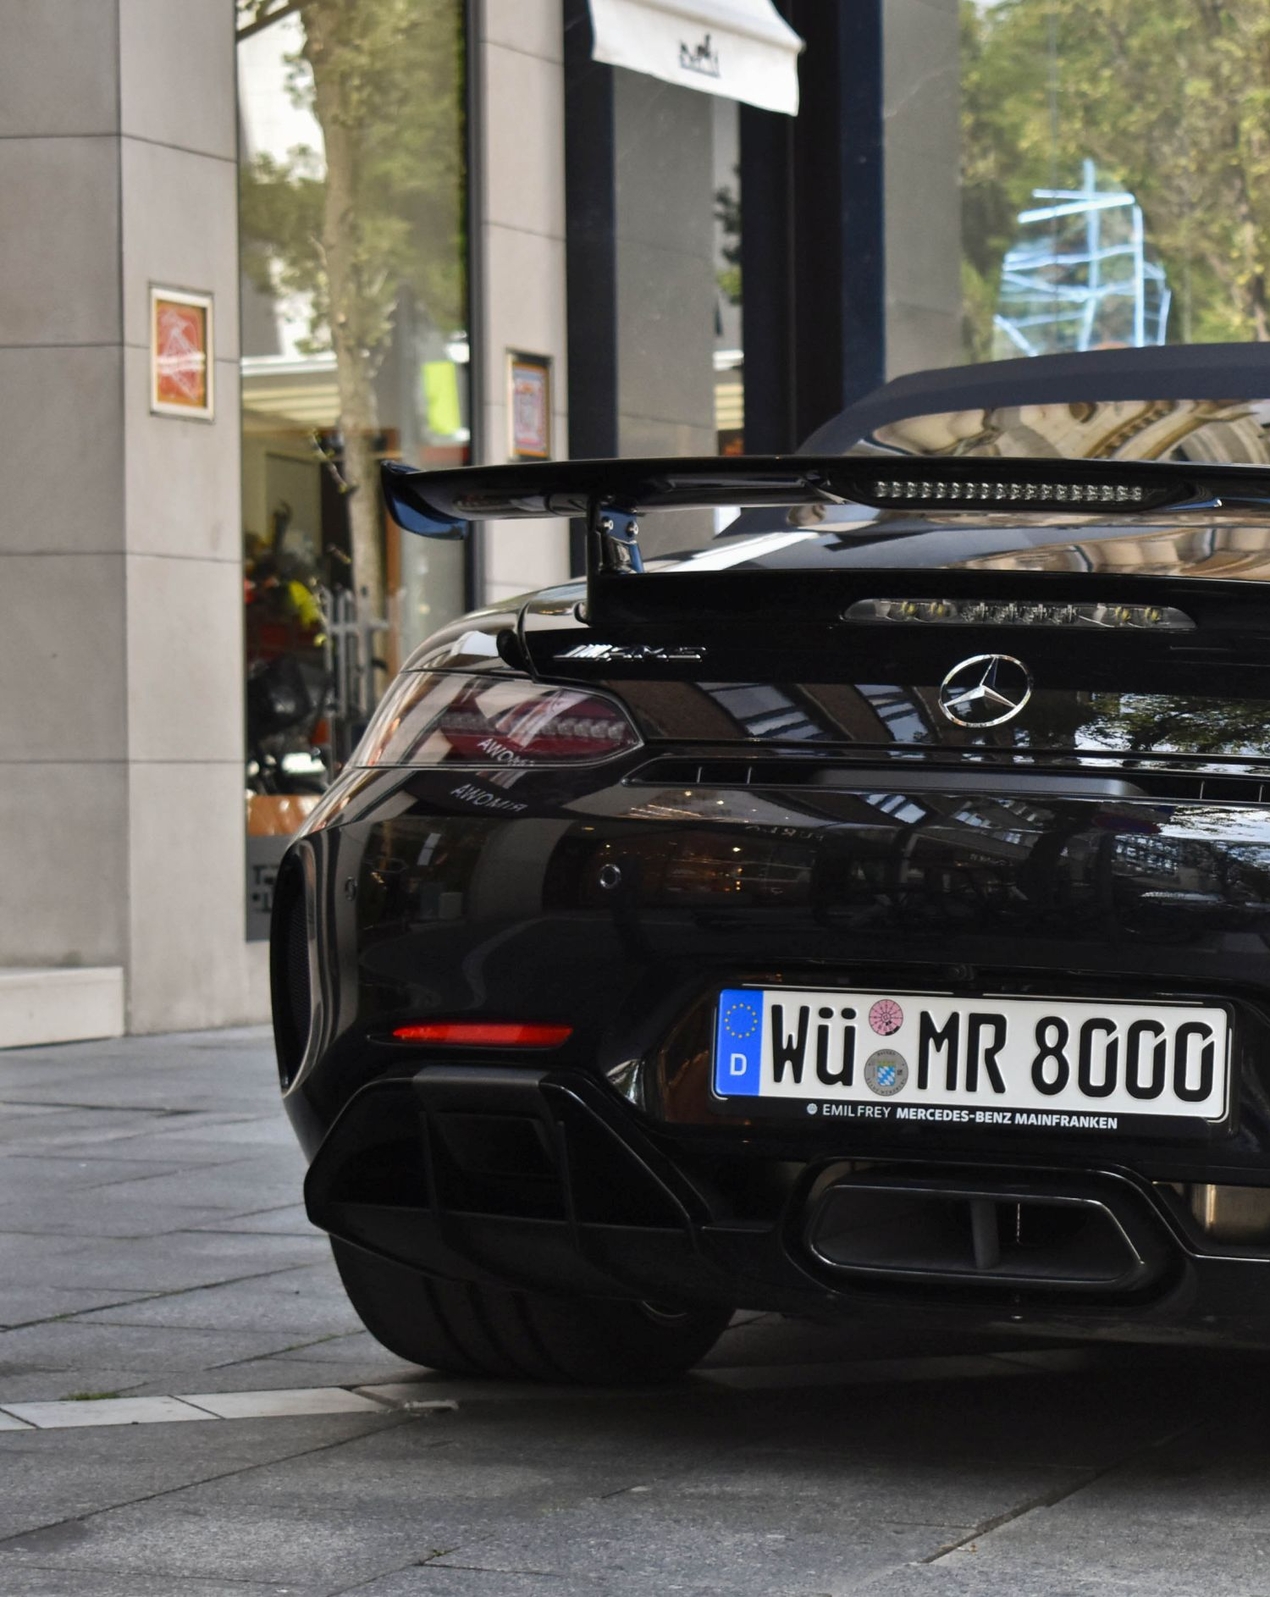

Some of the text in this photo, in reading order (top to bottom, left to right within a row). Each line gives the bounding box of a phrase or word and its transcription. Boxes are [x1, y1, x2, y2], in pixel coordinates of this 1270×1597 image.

[729, 1052, 748, 1077] D
[917, 1010, 1008, 1094] MR
[1030, 1016, 1215, 1103] 8000
[822, 1103, 1118, 1130] EMIL FREY MERCEDES-BENZ MAINFRANKEN
